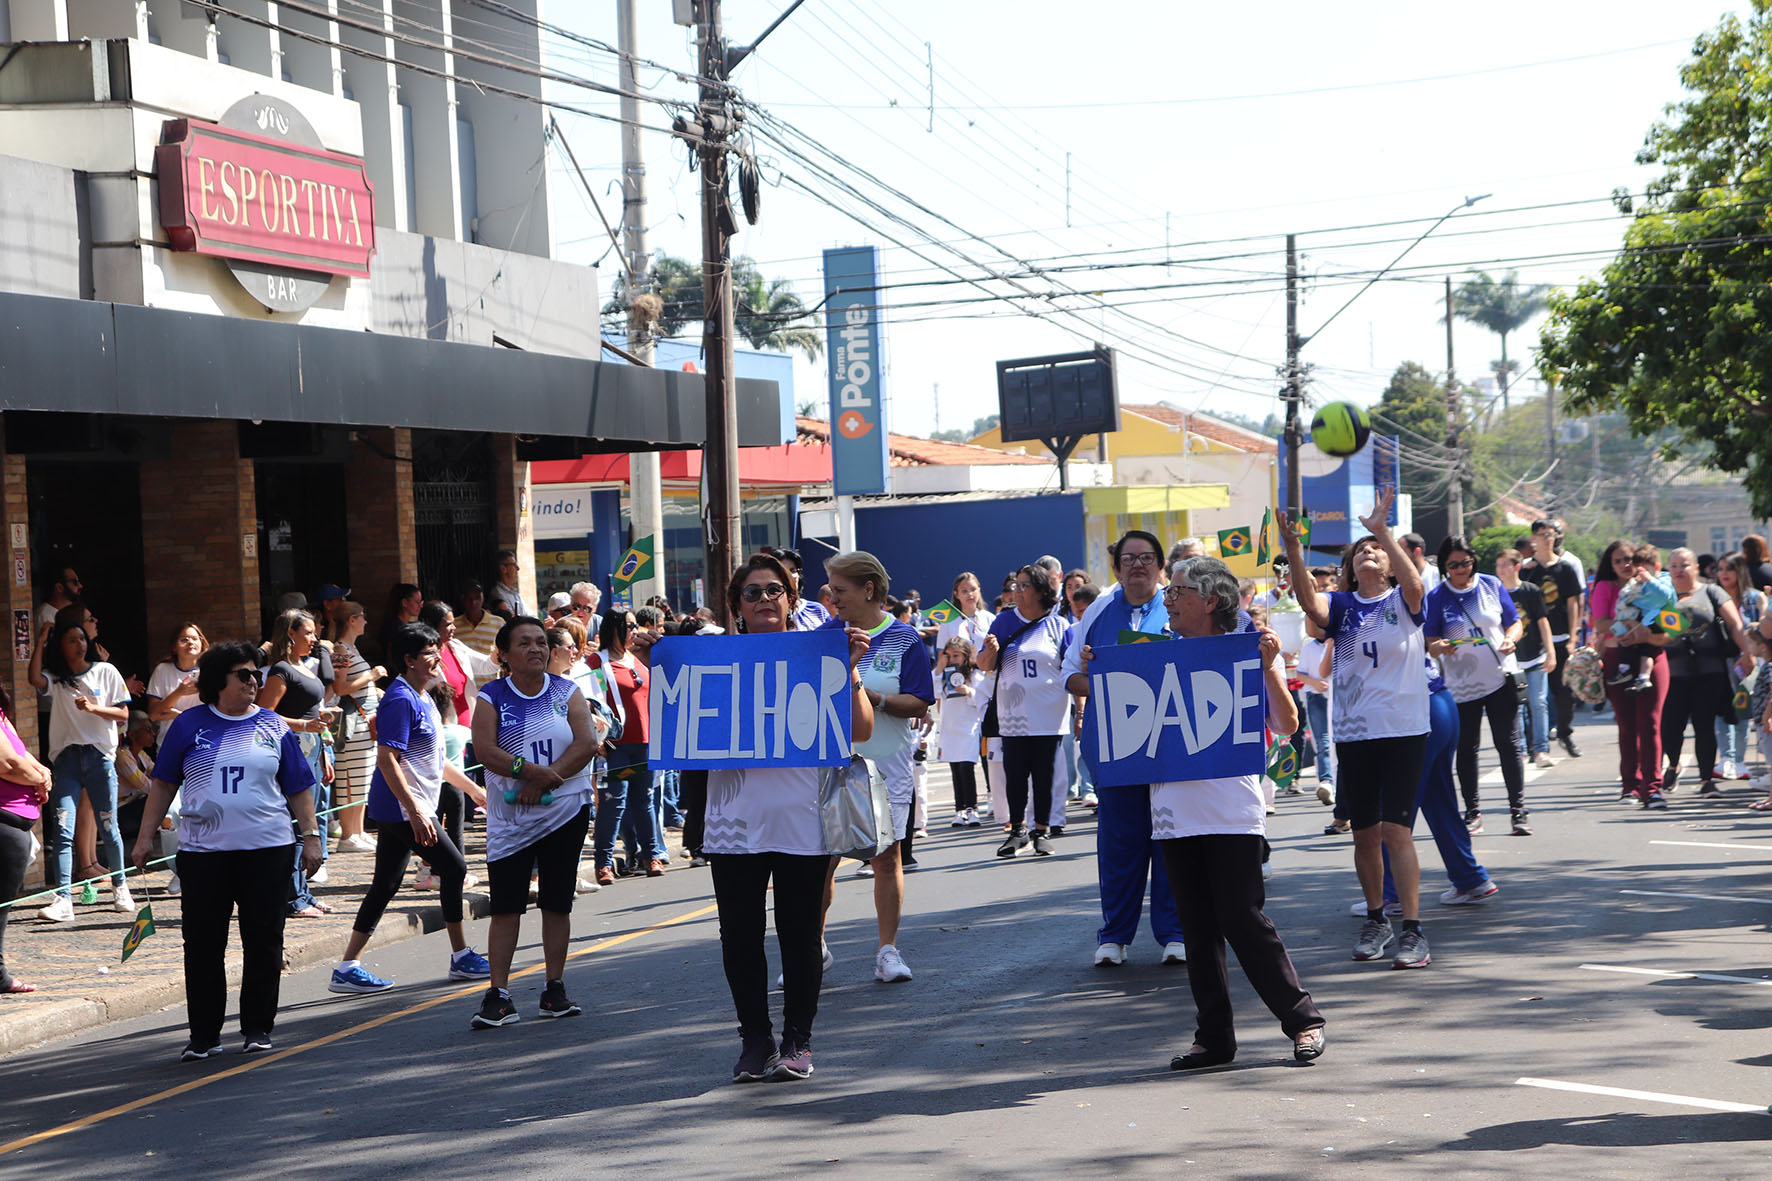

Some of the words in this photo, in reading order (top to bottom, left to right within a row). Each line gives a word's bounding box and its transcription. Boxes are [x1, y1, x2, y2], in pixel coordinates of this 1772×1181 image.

[198, 157, 364, 247] ESPORTIVA
[267, 274, 298, 302] BAR
[835, 346, 846, 381] Farma
[840, 303, 871, 408] Ponte
[1021, 659, 1037, 678] 19
[1363, 641, 1378, 668] 4
[649, 656, 851, 760] MELHOR
[1093, 658, 1261, 763] IDADE
[530, 738, 552, 766] 14
[220, 766, 244, 794] 17
